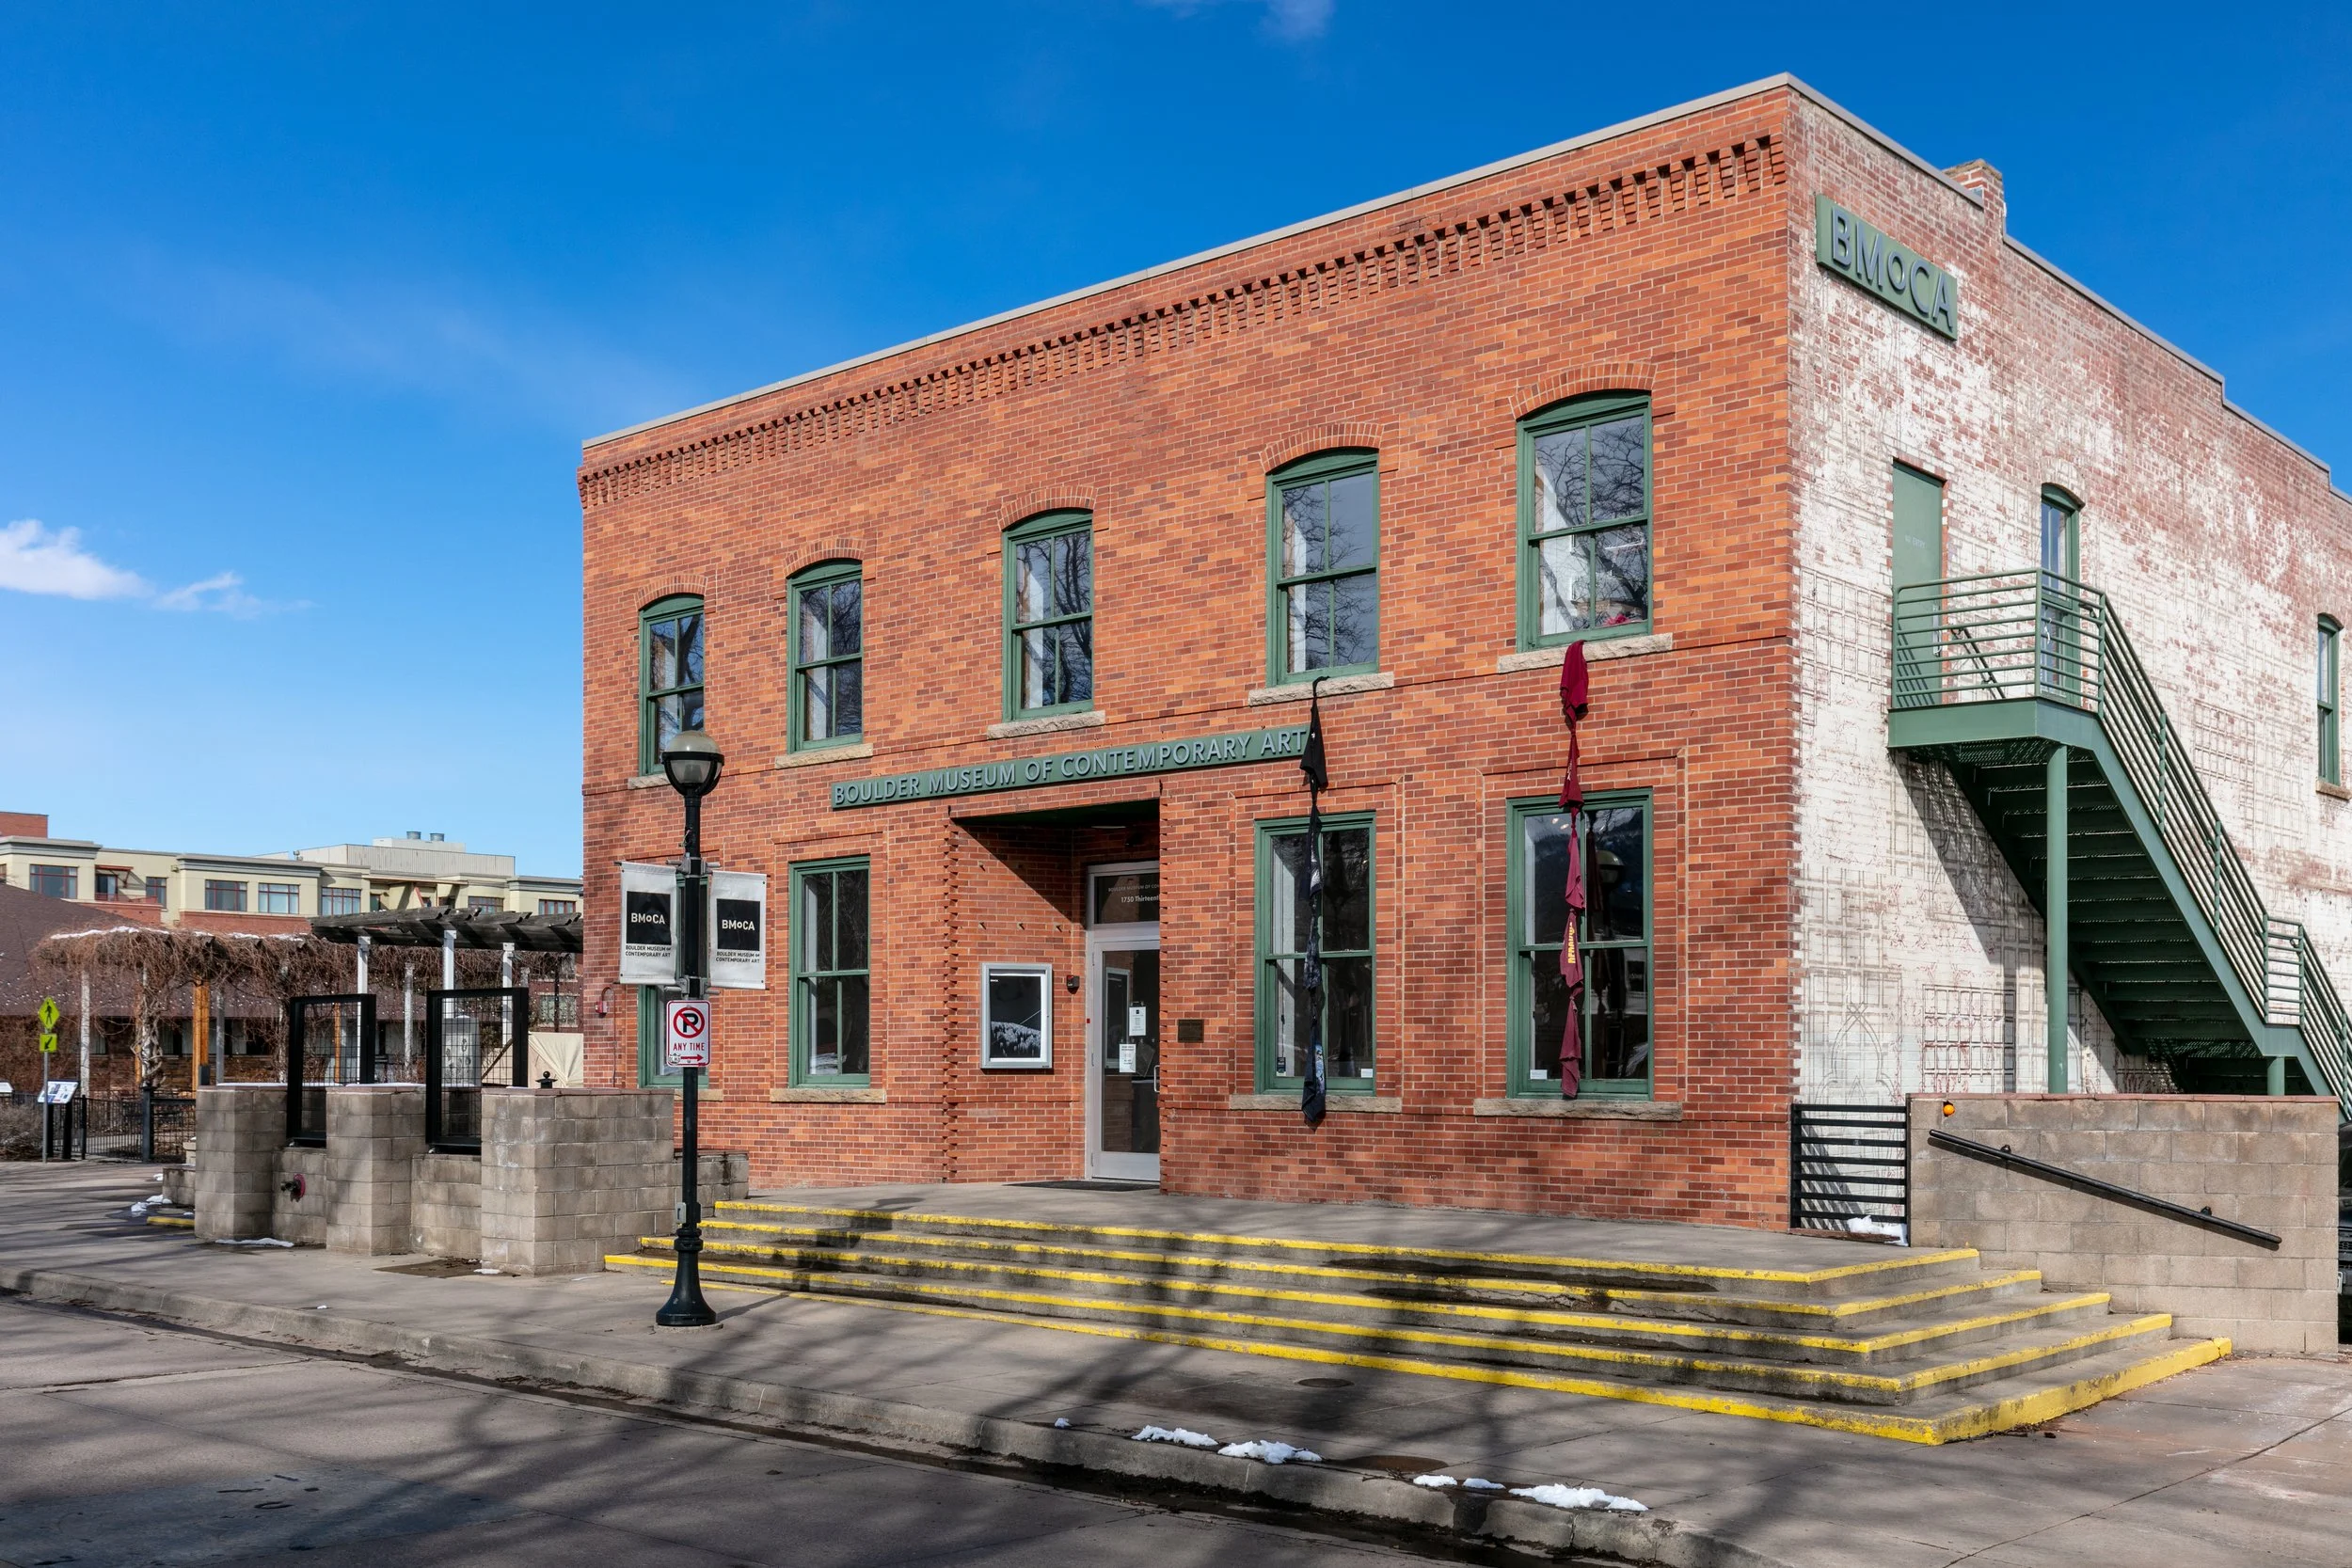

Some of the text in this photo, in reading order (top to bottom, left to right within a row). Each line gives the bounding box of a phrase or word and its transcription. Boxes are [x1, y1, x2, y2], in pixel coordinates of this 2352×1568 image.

[834, 728, 1308, 805] BOULDER MUSEUM OF CONTEMPORARY ART
[673, 1042, 705, 1052] ANY TIME
